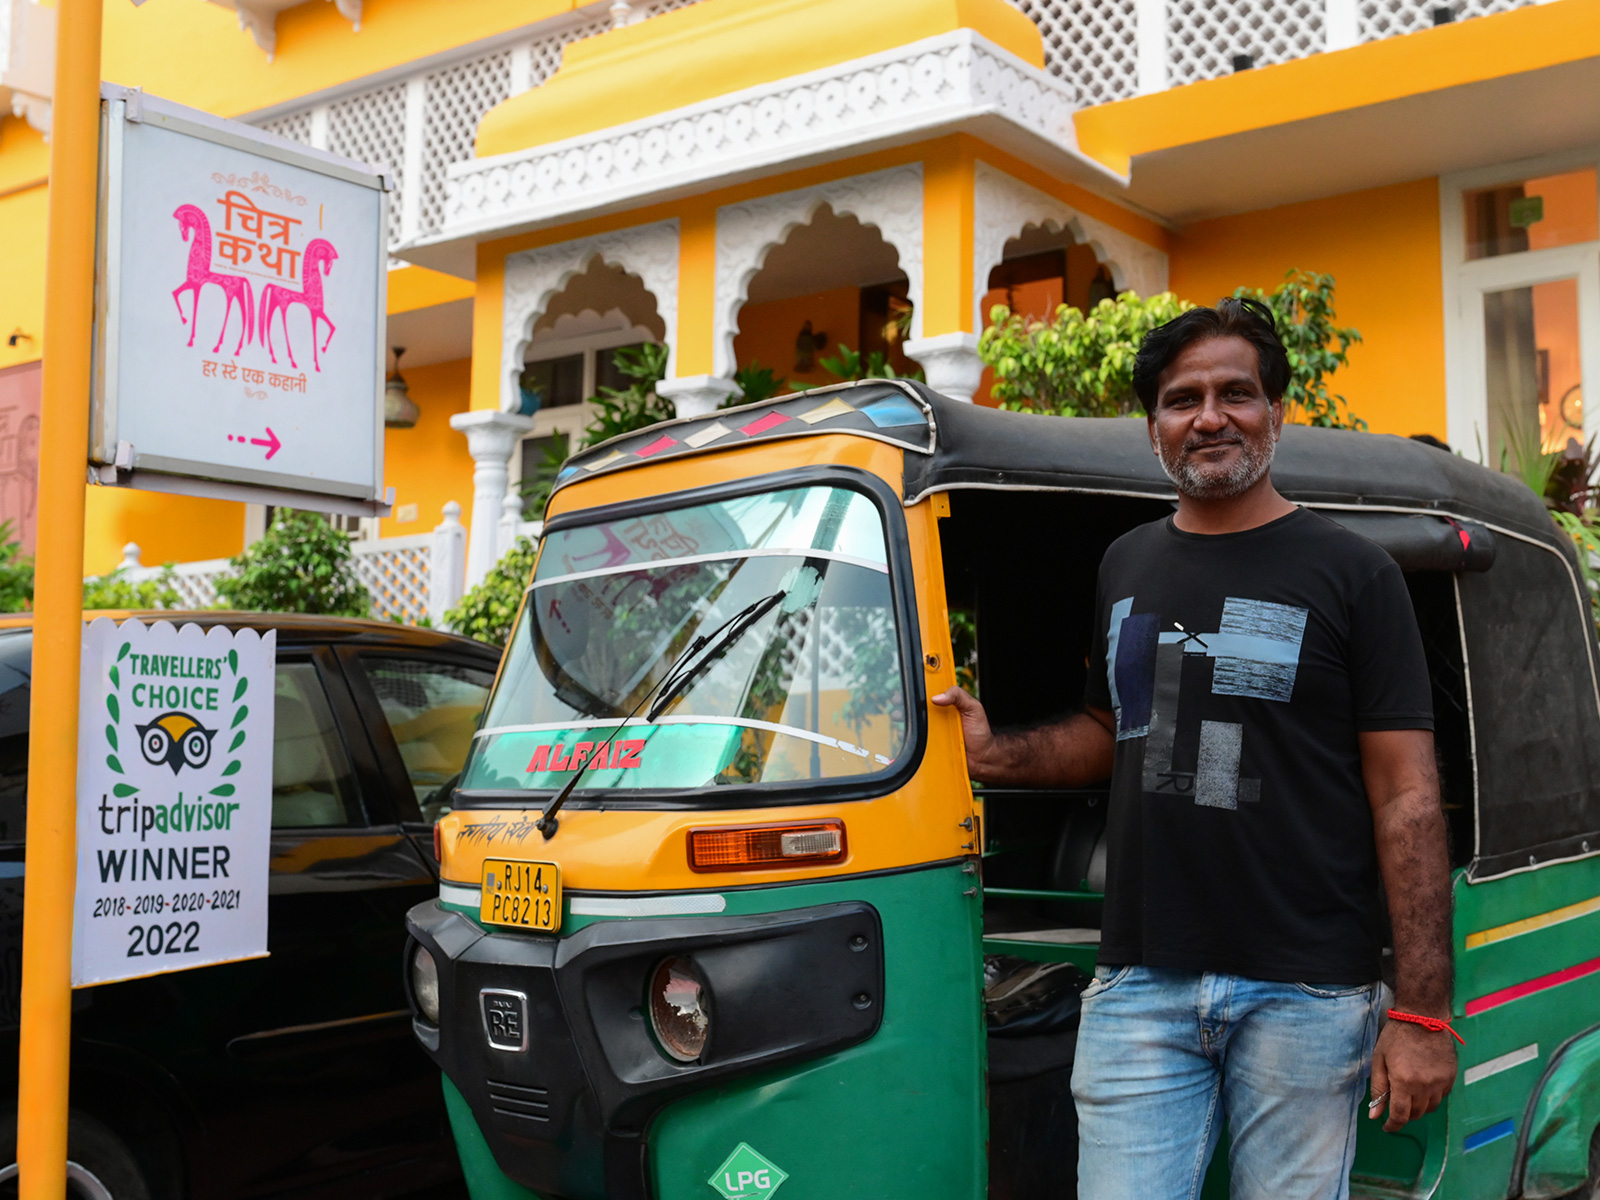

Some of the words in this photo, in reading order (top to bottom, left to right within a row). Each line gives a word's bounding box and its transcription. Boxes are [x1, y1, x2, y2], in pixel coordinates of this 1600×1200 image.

[217, 190, 302, 246] चित्र
[216, 231, 301, 279] कथा
[202, 360, 218, 377] हर
[221, 359, 238, 380] स्टे
[241, 367, 265, 385] एक
[268, 372, 307, 393] कहानी
[130, 653, 228, 680] TRAVELLERS'
[131, 683, 219, 711] CHOICE
[525, 739, 646, 773] ALFAIZ
[1156, 772, 1194, 792] R
[98, 792, 240, 842] tripadvisor
[97, 845, 230, 883] WINNER
[505, 864, 542, 893] RJ14
[493, 894, 551, 926] PC8213
[127, 921, 200, 957] 2022
[489, 1009, 521, 1038] RE
[725, 1169, 771, 1191] LPG
